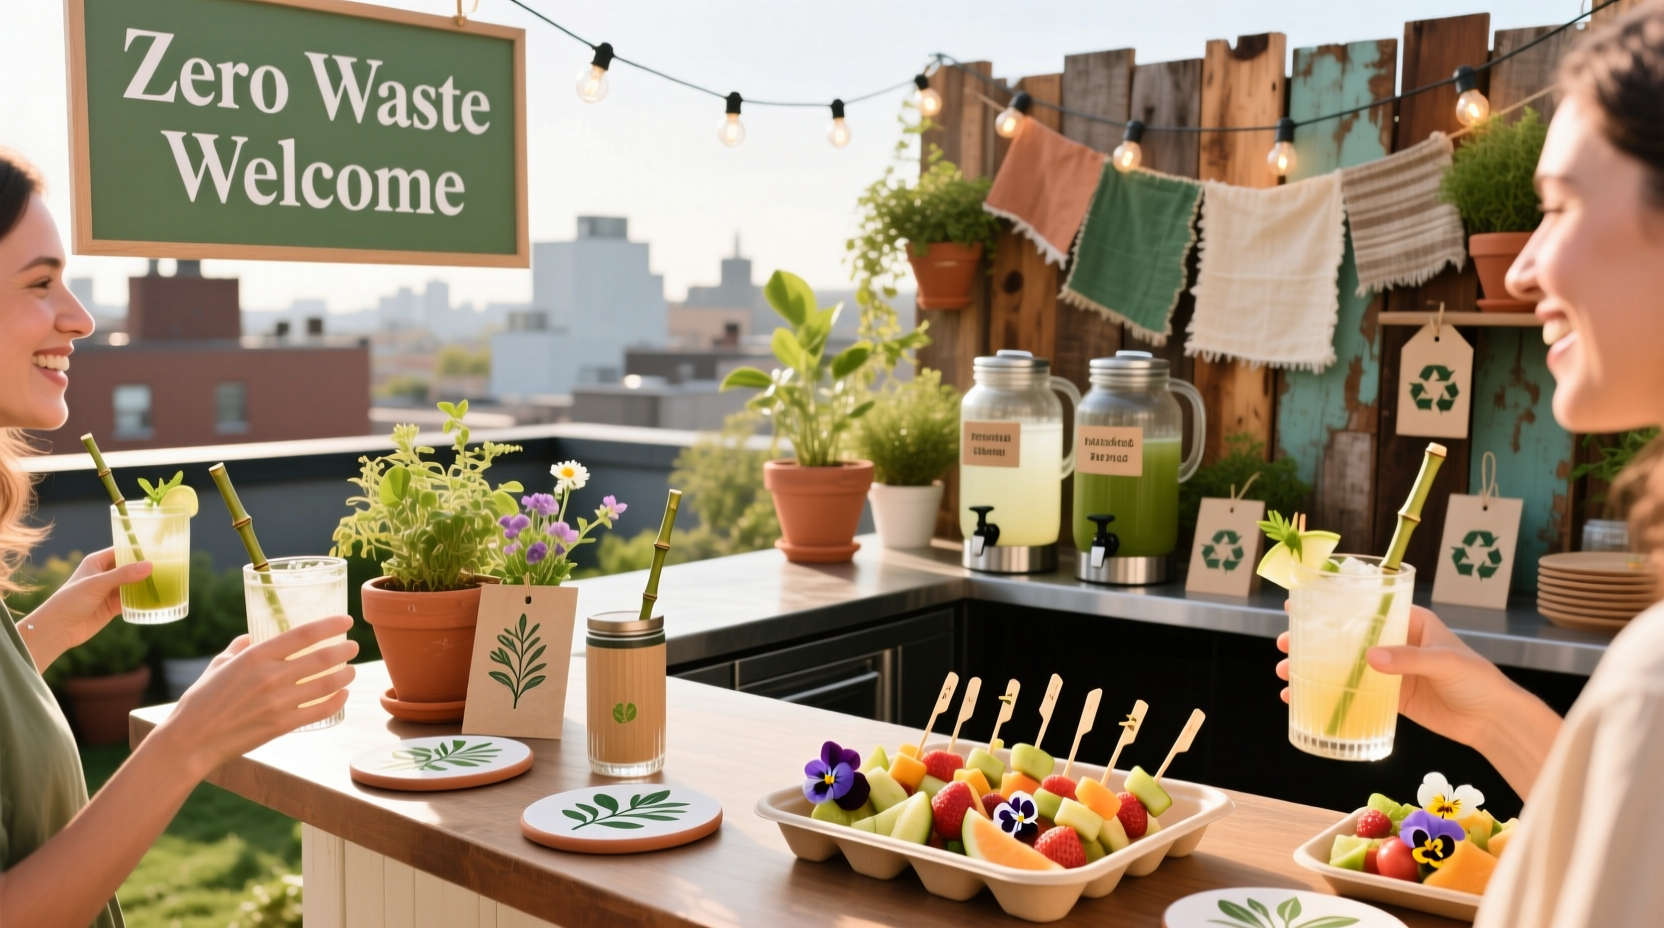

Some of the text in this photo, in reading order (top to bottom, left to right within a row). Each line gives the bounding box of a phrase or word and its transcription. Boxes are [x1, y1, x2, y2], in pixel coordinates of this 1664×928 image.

[123, 28, 491, 135] Zero Waste
[161, 130, 465, 217] Welcome
